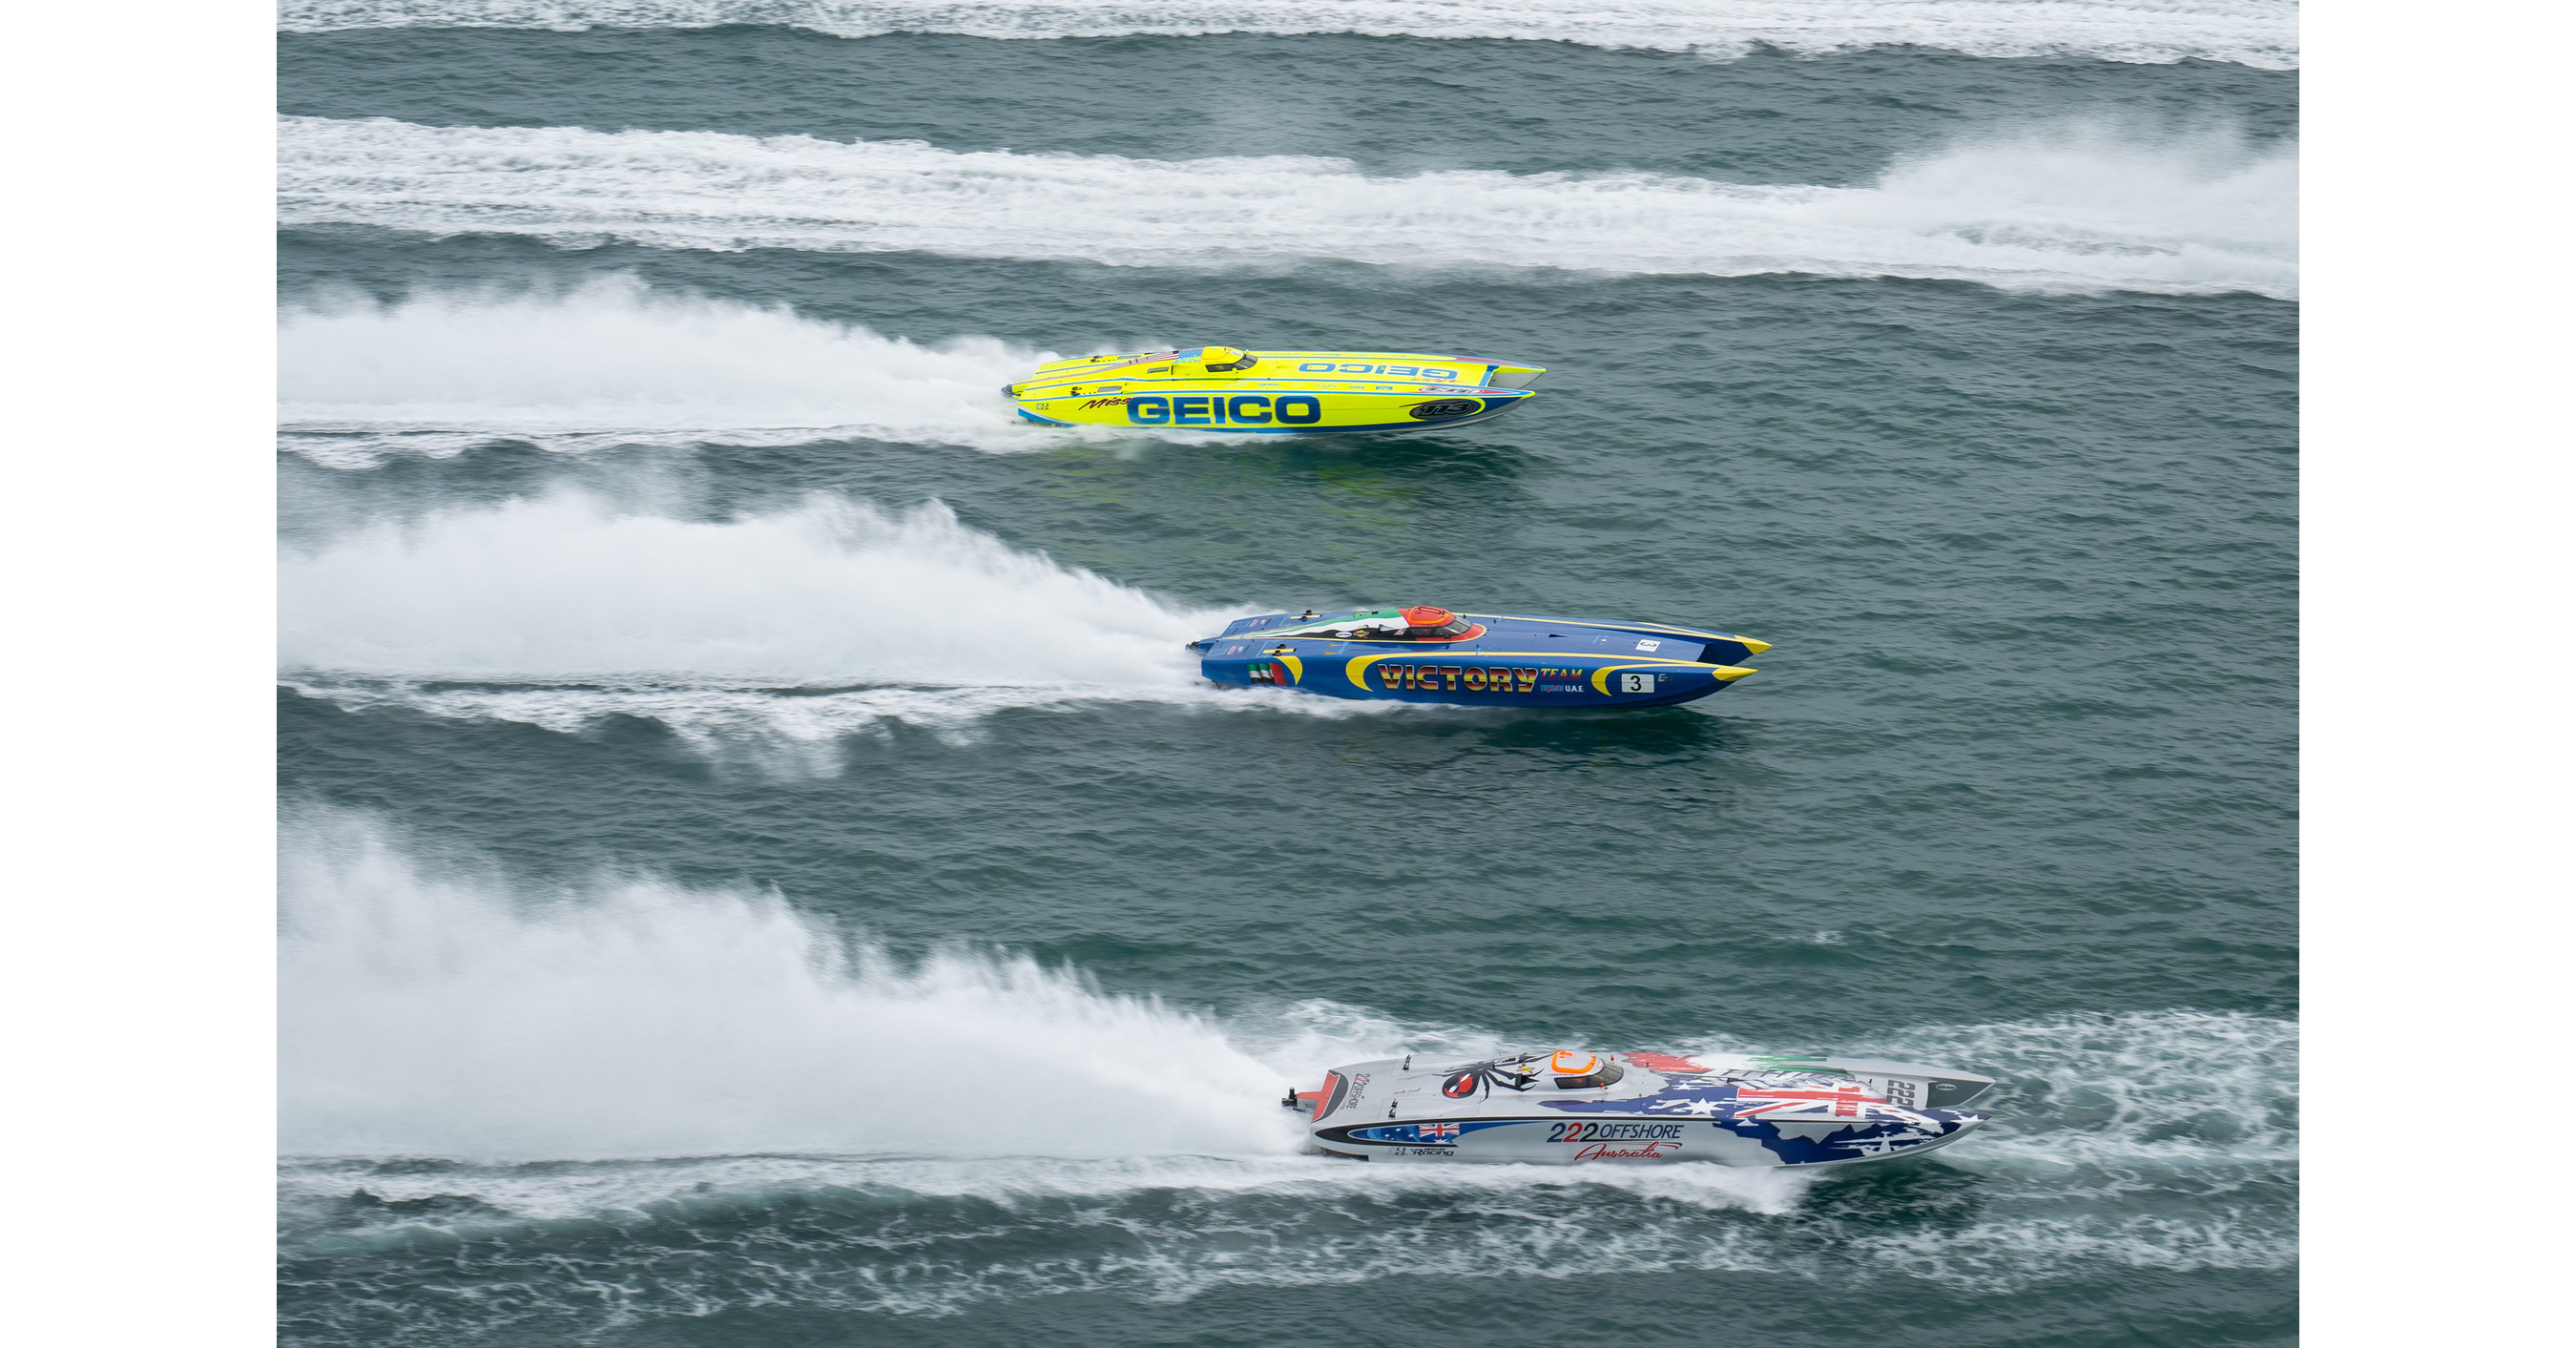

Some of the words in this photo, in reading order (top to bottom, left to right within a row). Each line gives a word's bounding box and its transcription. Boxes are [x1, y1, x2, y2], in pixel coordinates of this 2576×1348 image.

[1078, 397, 1132, 410] Miss
[1127, 395, 1321, 425] GEICO
[1419, 402, 1470, 417] 113
[1377, 663, 1539, 694] VICTORY
[1541, 668, 1583, 680] TEAM
[1630, 674, 1642, 692] 3
[1346, 1085, 1364, 1110] OFFSHORE
[1886, 1079, 1916, 1107] 222
[1546, 1122, 1599, 1143] 222
[1599, 1124, 1685, 1139] OFFSHORE
[1574, 1141, 1664, 1161] Australia
